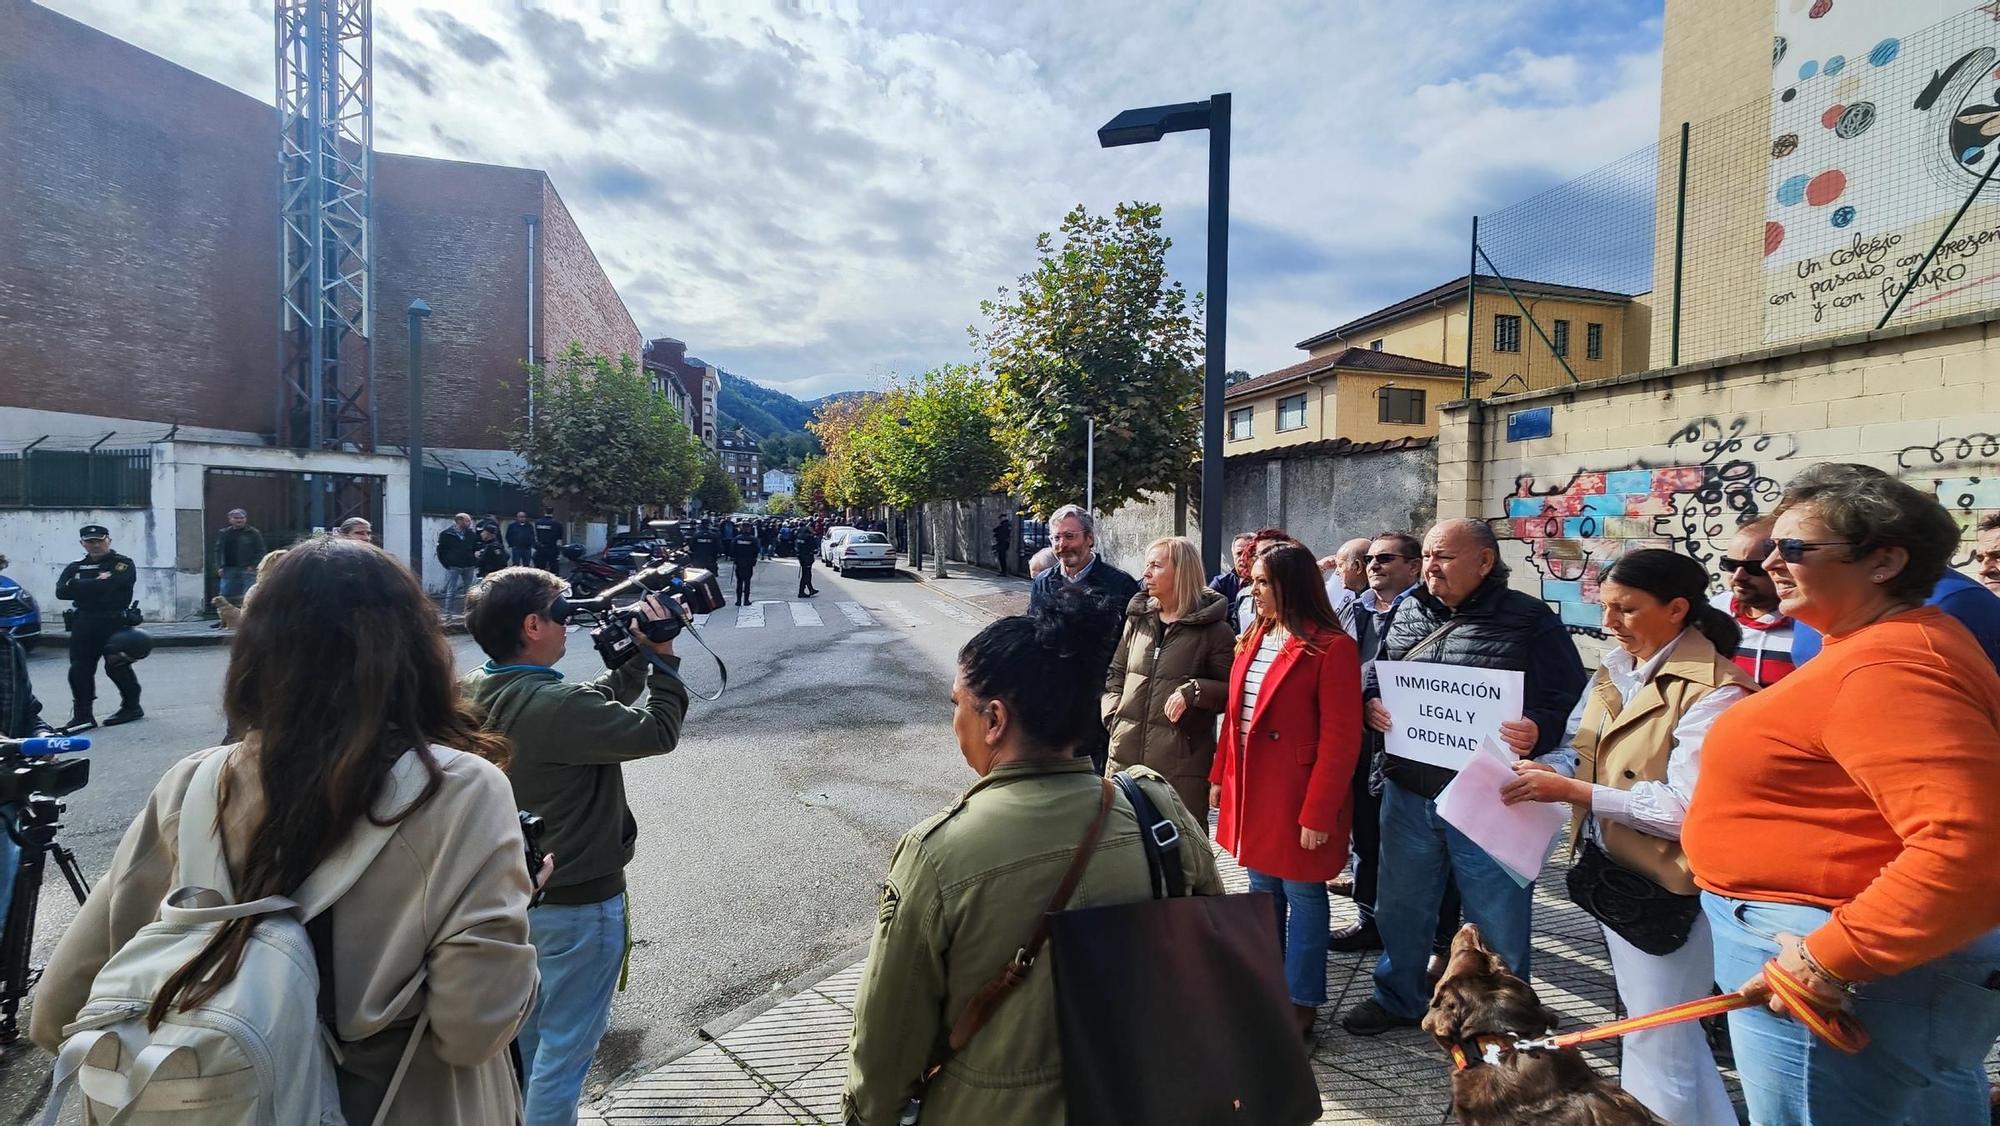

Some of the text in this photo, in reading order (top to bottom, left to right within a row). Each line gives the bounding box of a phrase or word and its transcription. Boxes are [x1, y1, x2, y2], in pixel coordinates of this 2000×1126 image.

[1769, 291, 1797, 306] con
[1810, 263, 1886, 300] pasado
[1896, 252, 1926, 268] con
[1797, 258, 1822, 279] Un
[1812, 301, 1828, 323] y
[1832, 292, 1865, 308] con
[1395, 675, 1501, 700] INMIGRACIÓN
[1419, 703, 1476, 725] LEGAL Y
[47, 738, 72, 750] tve
[1407, 726, 1479, 752] ORDENAD
